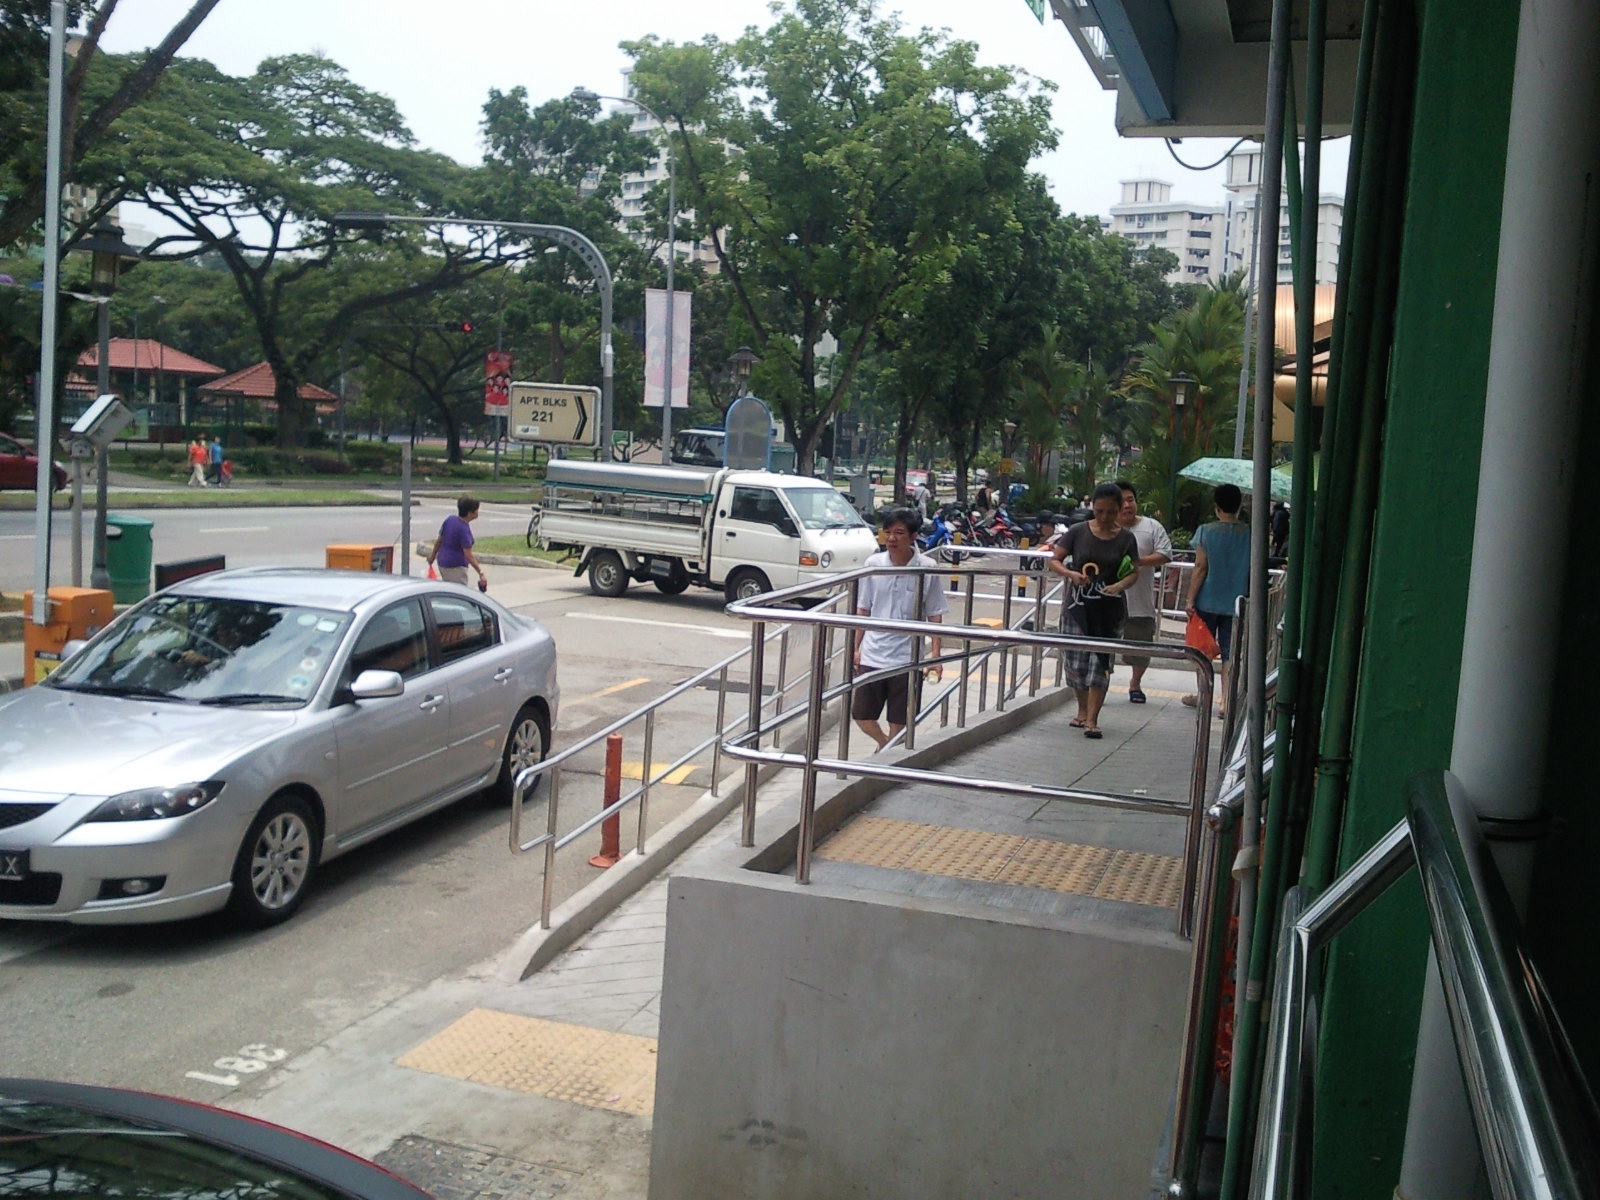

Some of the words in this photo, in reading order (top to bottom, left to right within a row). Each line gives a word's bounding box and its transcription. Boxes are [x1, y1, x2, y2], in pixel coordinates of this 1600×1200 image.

[520, 395, 539, 406] APT.
[543, 397, 568, 408] BLKS
[531, 411, 553, 423] 221
